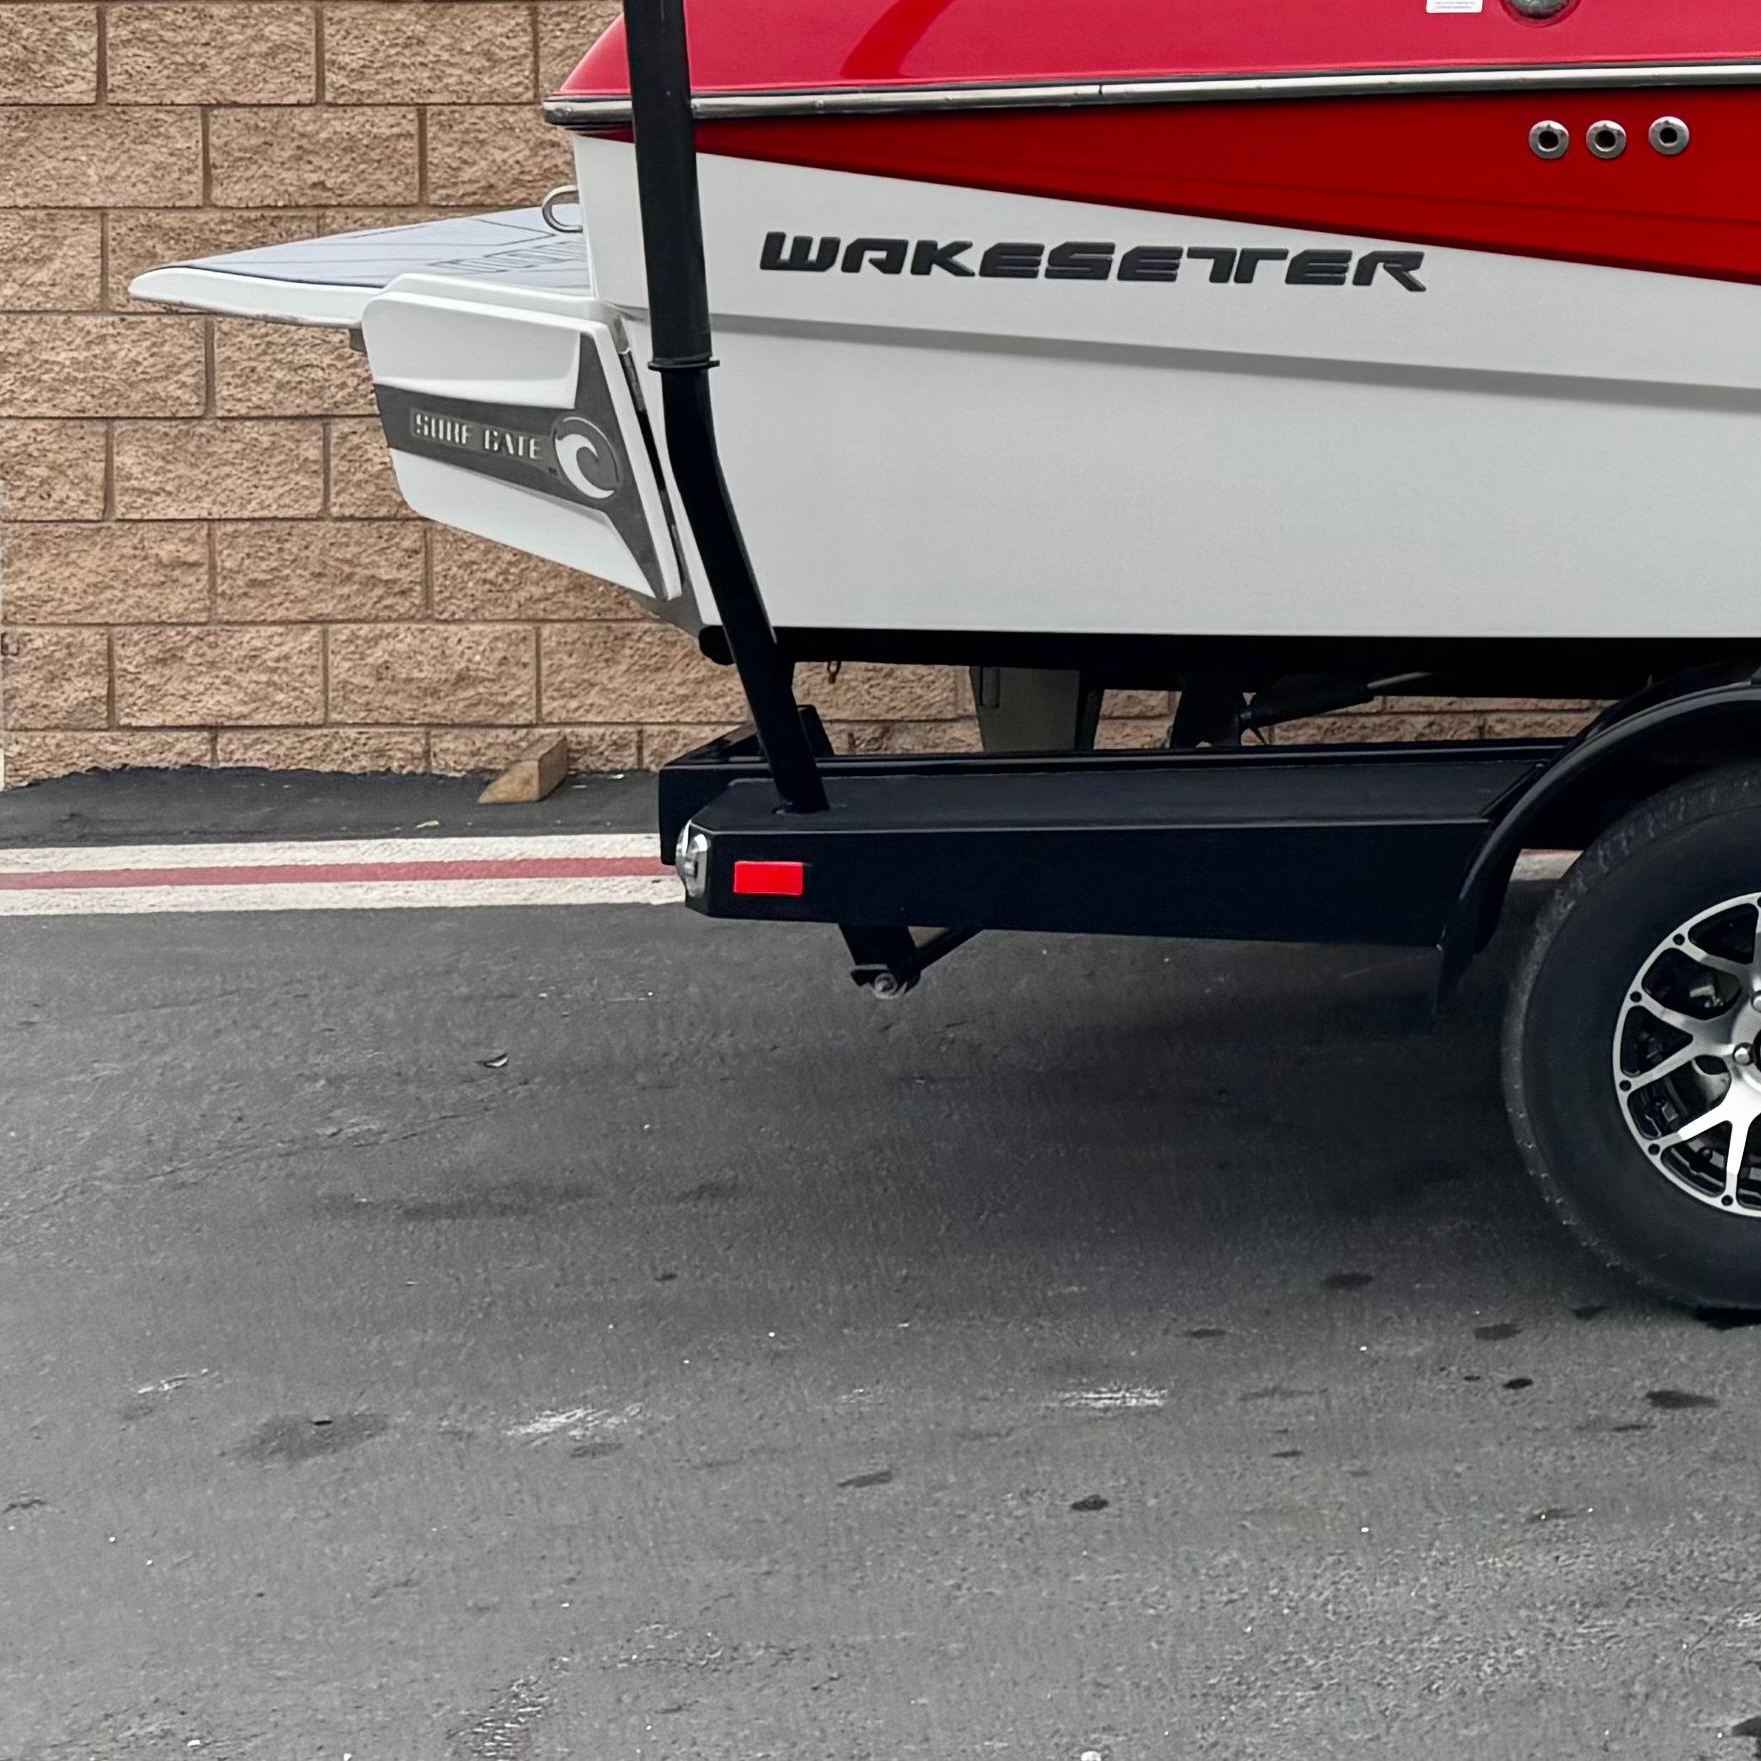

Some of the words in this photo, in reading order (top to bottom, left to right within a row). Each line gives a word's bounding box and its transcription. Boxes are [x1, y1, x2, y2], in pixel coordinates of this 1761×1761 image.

[760, 231, 1427, 292] WAKESETTER
[416, 413, 471, 444] SURF
[484, 428, 543, 459] GATE
